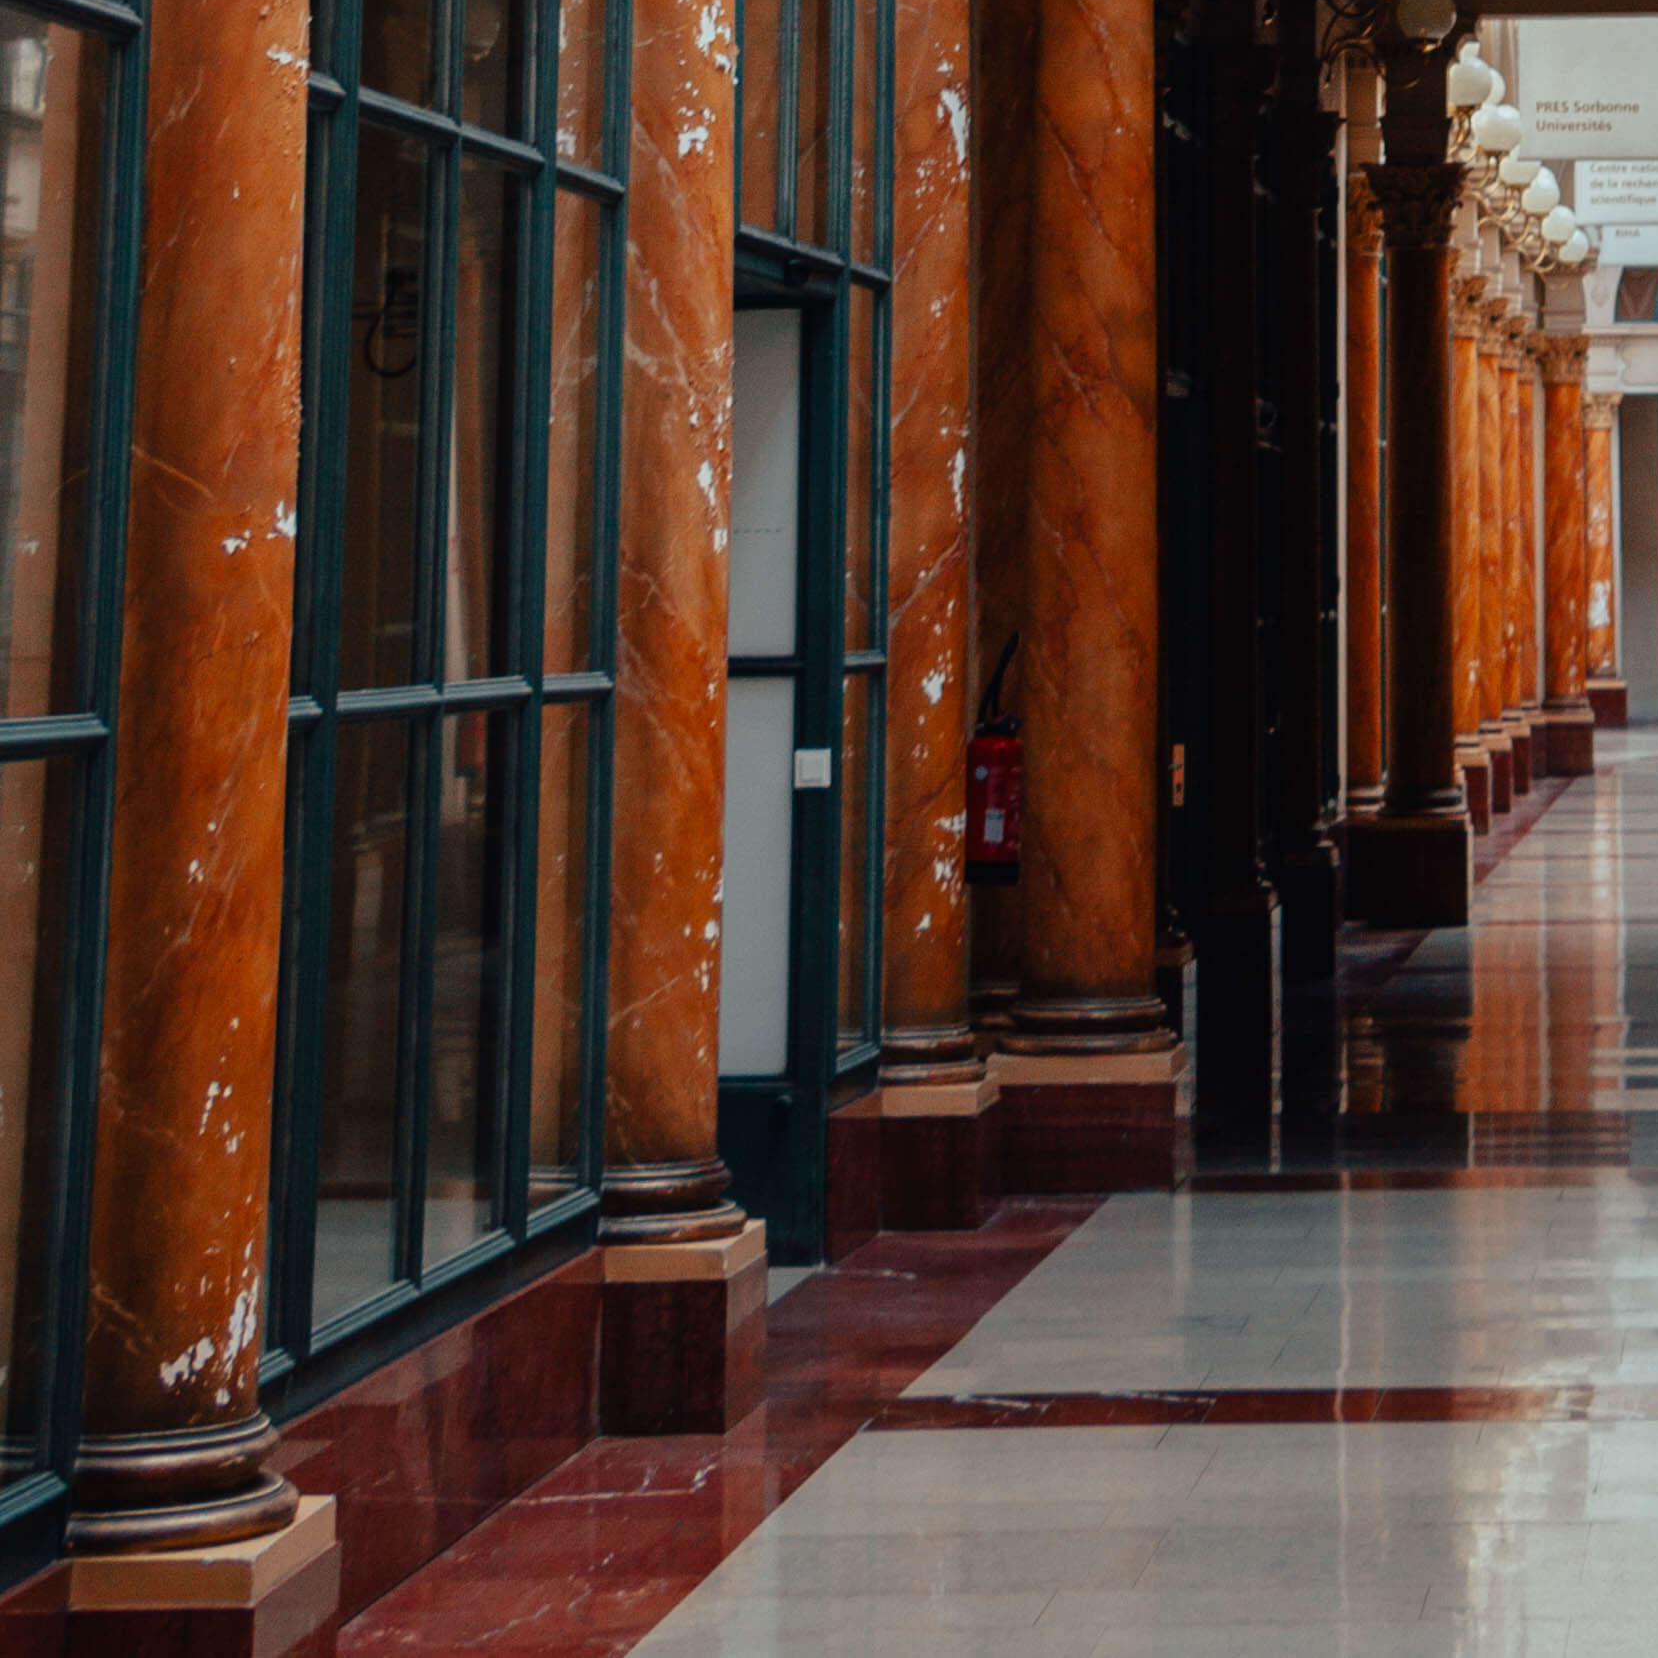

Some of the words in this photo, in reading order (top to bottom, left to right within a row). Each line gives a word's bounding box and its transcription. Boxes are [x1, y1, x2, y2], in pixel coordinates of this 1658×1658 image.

[1535, 100, 1569, 113] PRES
[1574, 100, 1640, 113] Sorbonne
[1536, 118, 1612, 132] Universités
